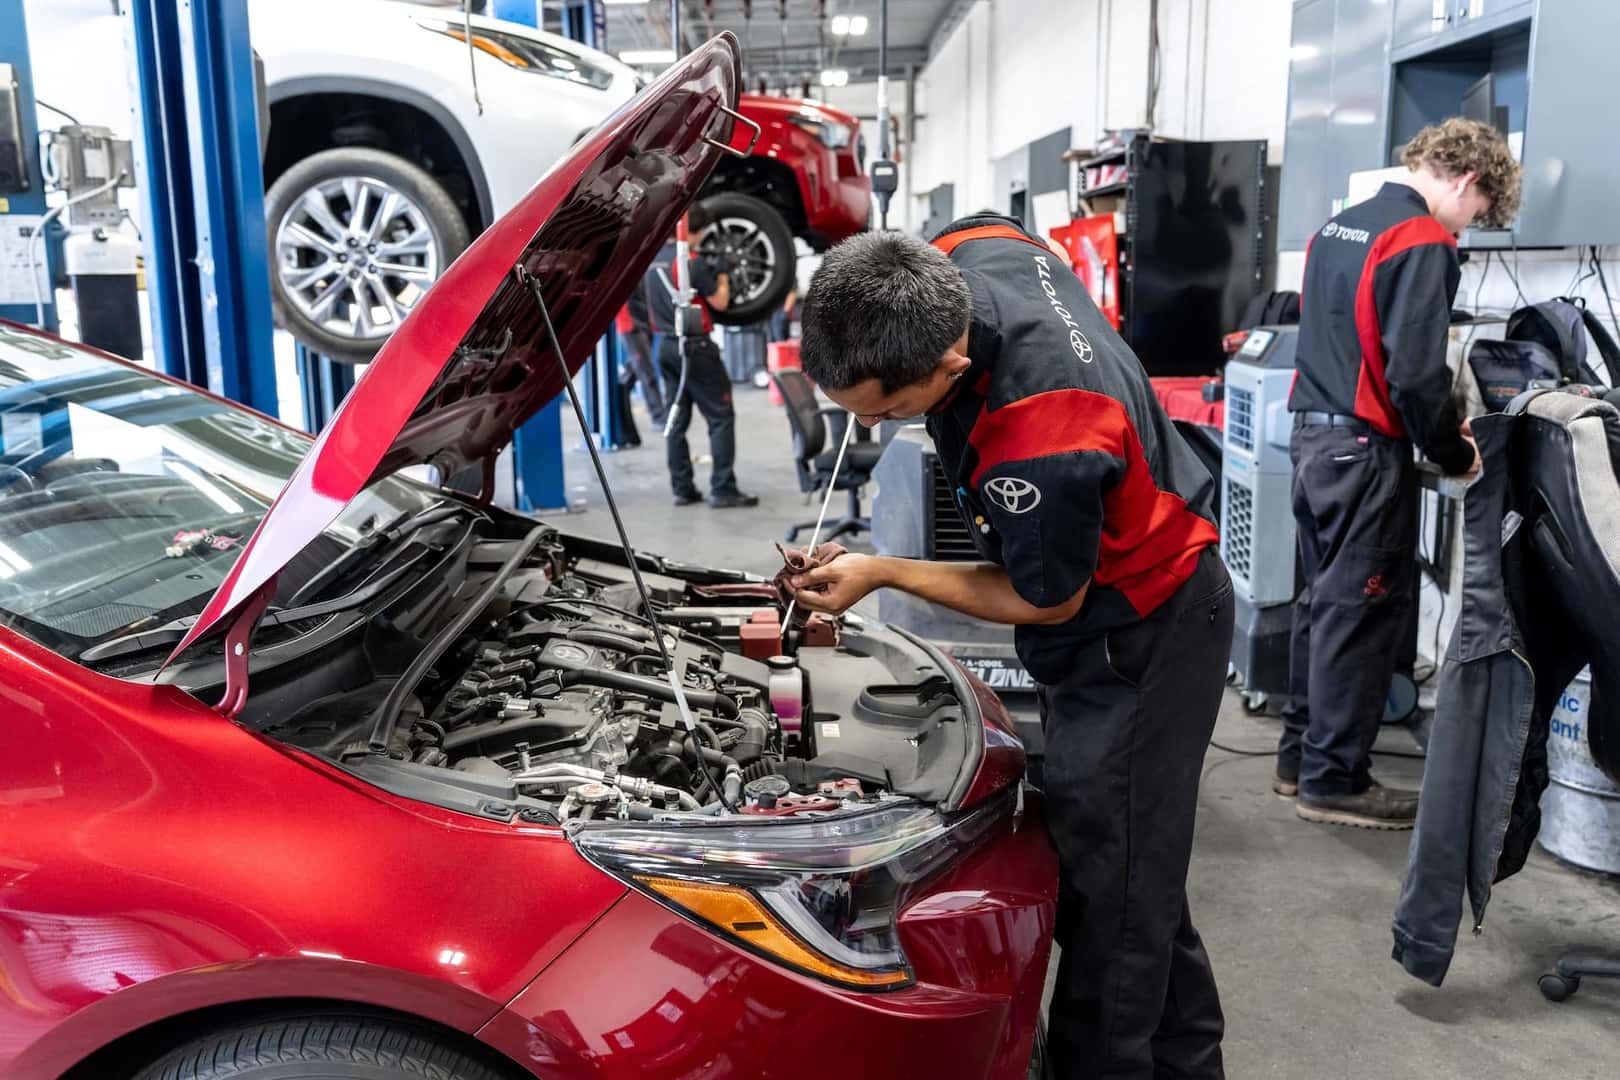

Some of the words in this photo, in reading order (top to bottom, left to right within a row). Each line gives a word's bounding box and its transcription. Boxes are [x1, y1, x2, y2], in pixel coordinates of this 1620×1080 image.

[1336, 226, 1370, 244] TOYOTA
[1033, 255, 1079, 328] TOYOTA
[1558, 688, 1580, 713] ic
[1551, 718, 1581, 741] ant
